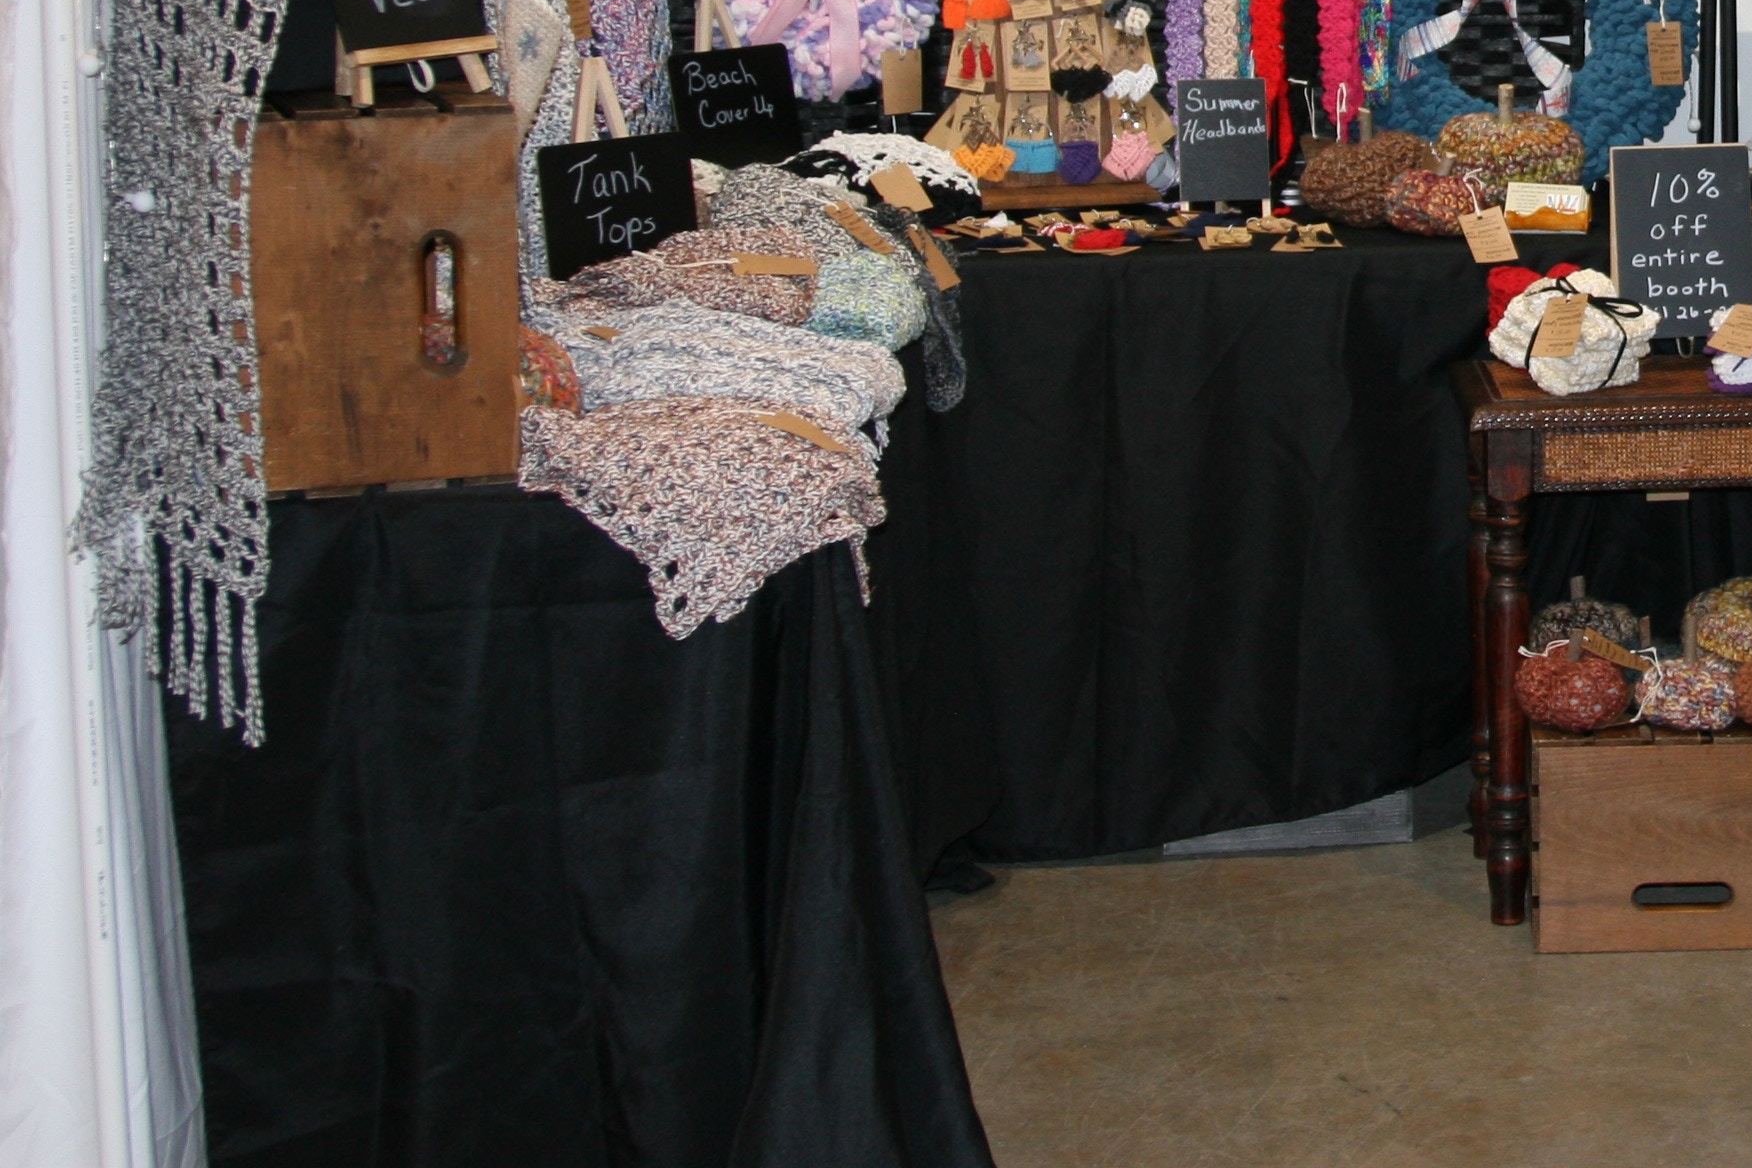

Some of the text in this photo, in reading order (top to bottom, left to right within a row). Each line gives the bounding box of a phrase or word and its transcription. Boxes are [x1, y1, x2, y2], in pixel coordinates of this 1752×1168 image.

[682, 59, 758, 95] Beach
[698, 99, 749, 128] Cover
[1185, 88, 1261, 112] Summer
[1182, 118, 1266, 143] Headbands
[567, 152, 652, 204] Tank
[1650, 168, 1720, 208] 10%
[586, 207, 657, 249] Tops
[1650, 214, 1708, 240] off
[1631, 248, 1724, 268] entire
[1648, 276, 1729, 298] booth
